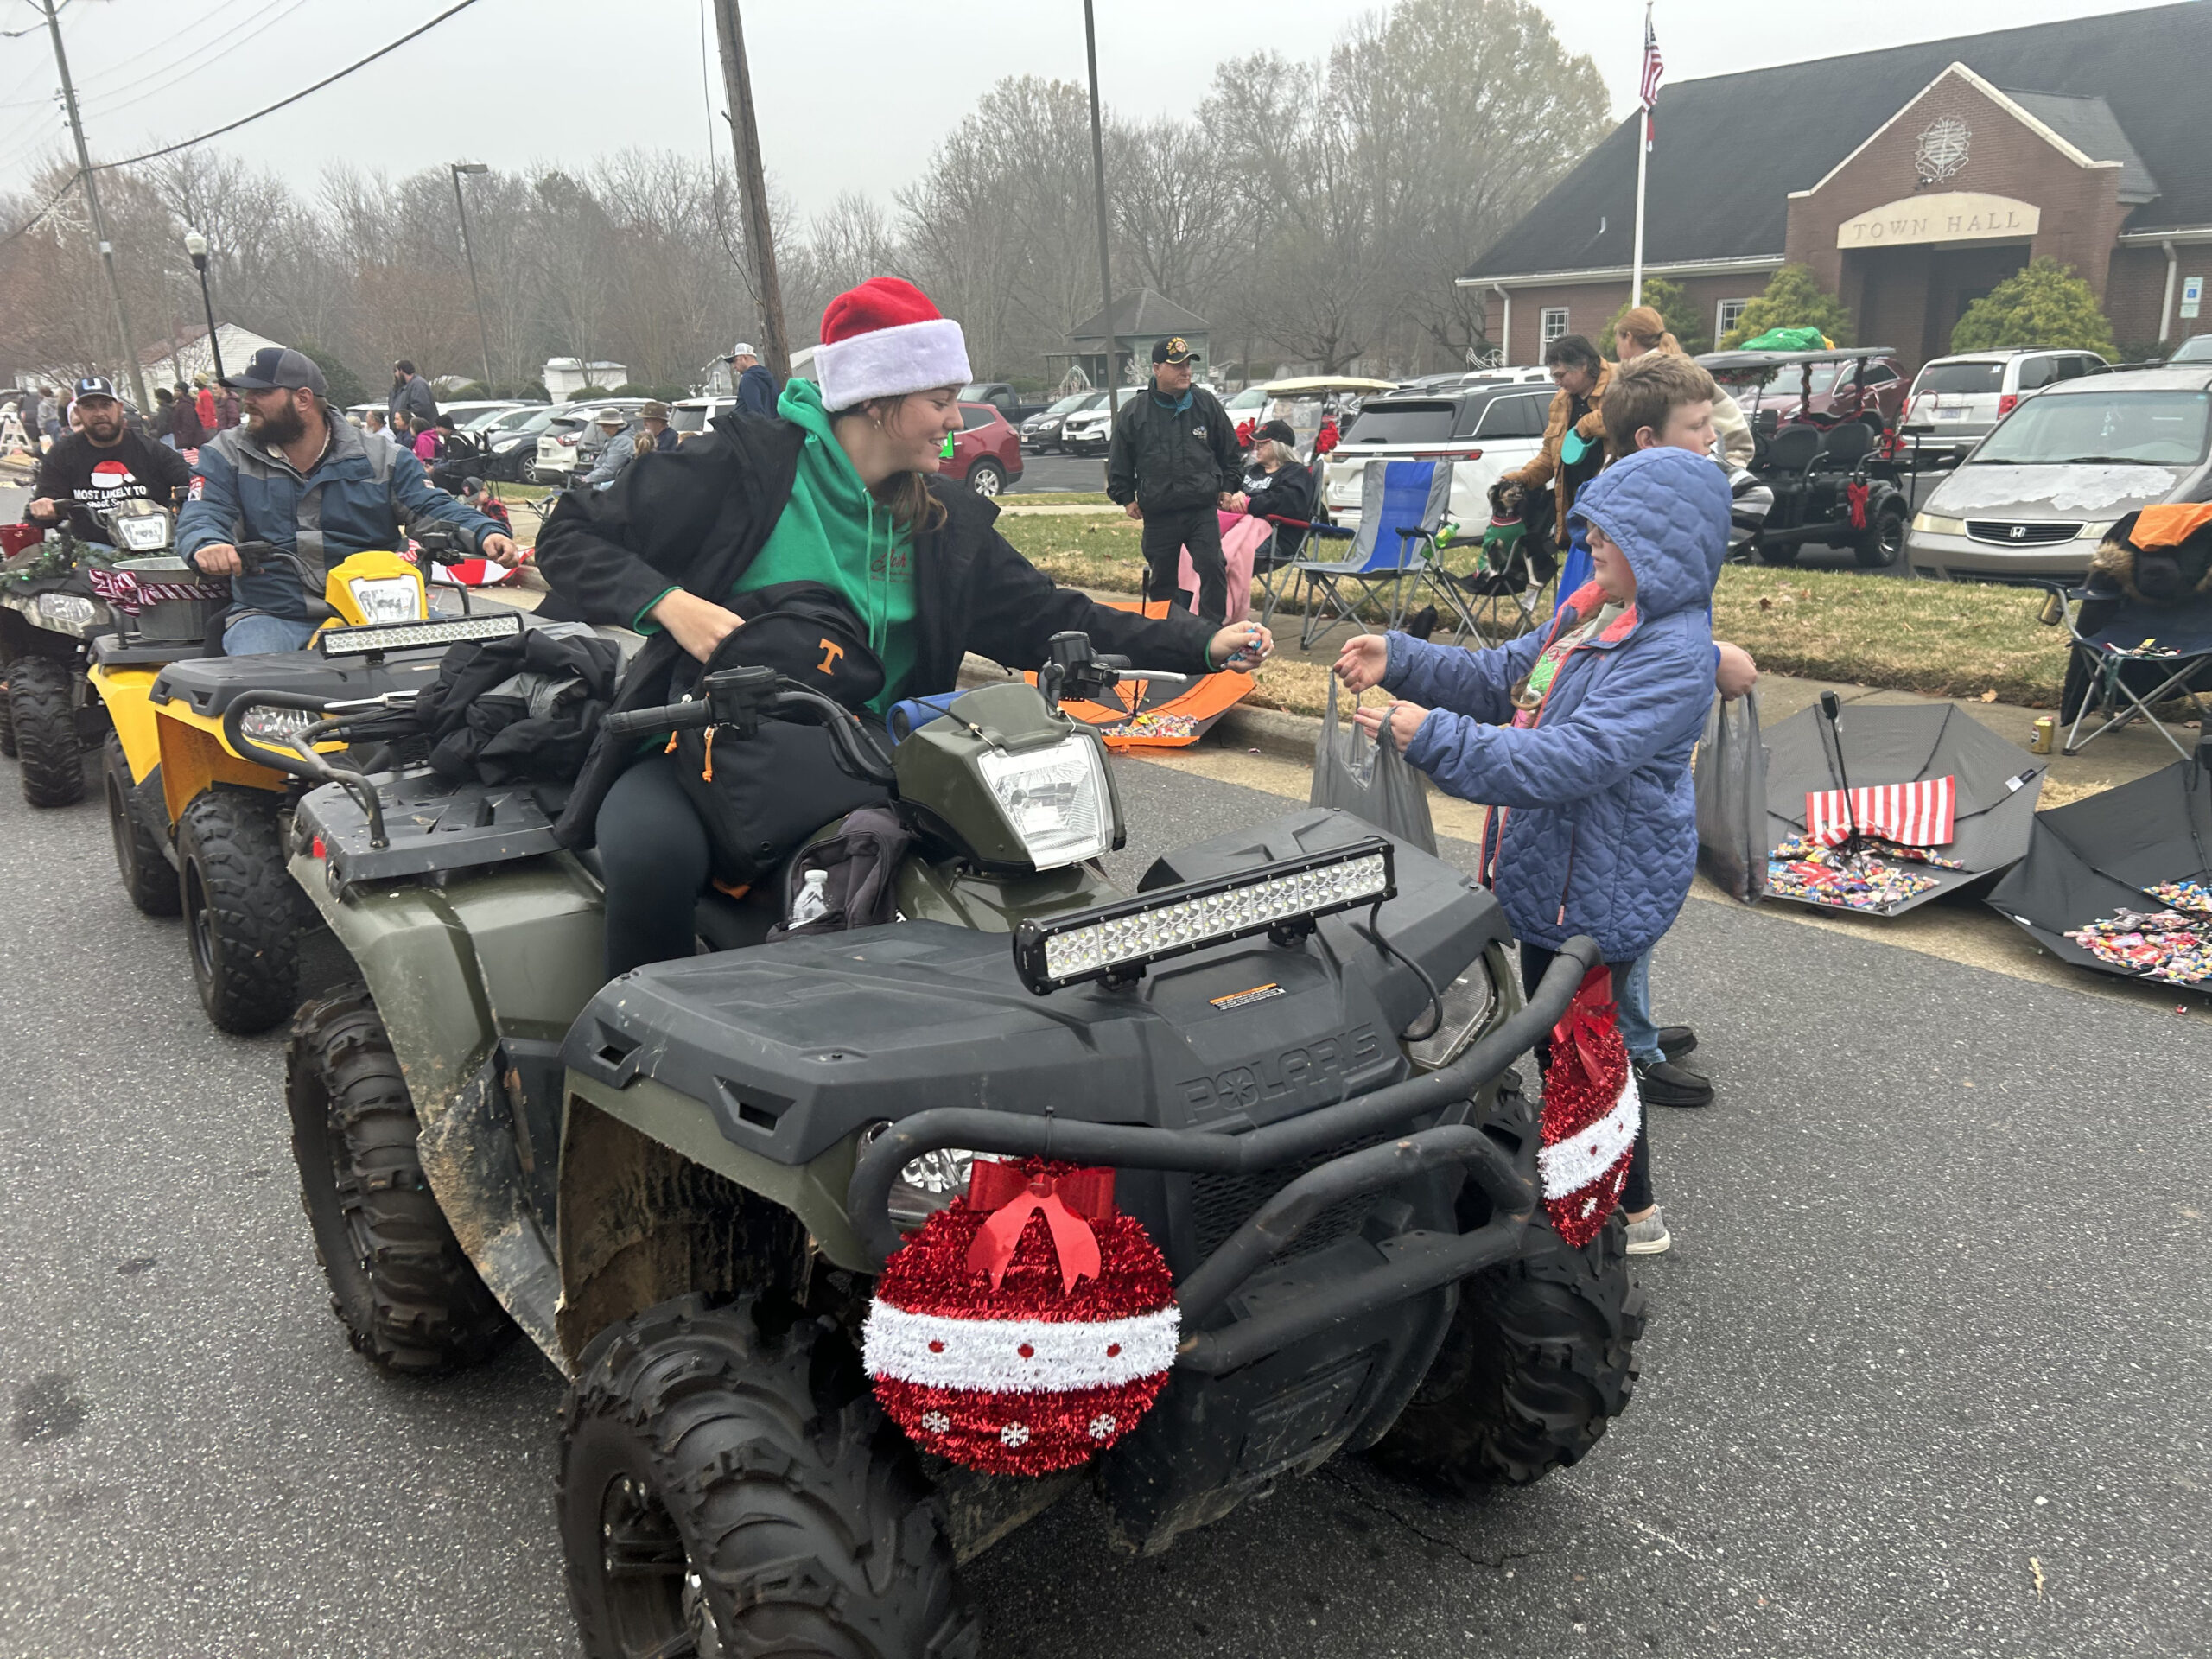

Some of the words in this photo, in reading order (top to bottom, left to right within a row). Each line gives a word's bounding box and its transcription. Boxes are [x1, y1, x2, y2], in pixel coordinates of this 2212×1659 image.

[1853, 218, 1928, 239] TOWN
[1946, 211, 2021, 232] HALL
[81, 378, 102, 390] U
[73, 489, 99, 499] MOST
[101, 486, 131, 499] LIKELY
[132, 485, 147, 496] TO
[817, 637, 844, 674] T
[1174, 1021, 1385, 1124] POLARIS
